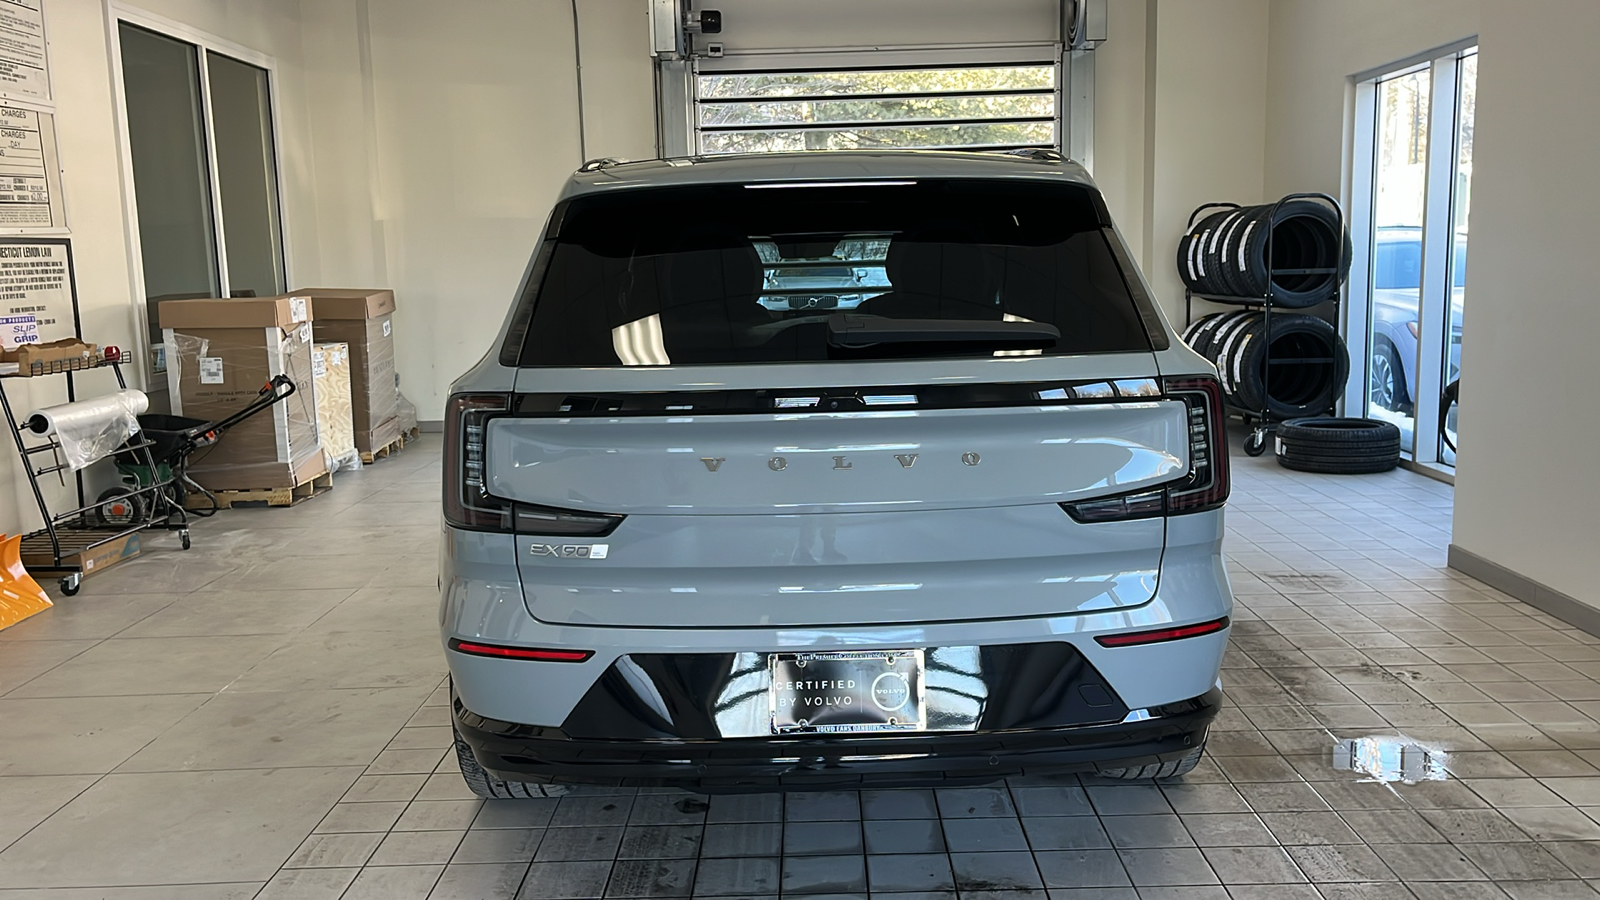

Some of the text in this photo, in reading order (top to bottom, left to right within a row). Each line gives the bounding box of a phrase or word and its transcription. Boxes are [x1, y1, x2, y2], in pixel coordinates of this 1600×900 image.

[1, 109, 26, 119] CHARGES
[1, 130, 26, 139] CHARGES
[23, 247, 40, 258] LEMON
[41, 247, 52, 258] LAW
[13, 324, 36, 333] SLIP
[14, 335, 38, 343] GRIP
[700, 451, 981, 472] VOLVO
[530, 543, 590, 558] EX90
[775, 680, 856, 690] CERTIFIED
[779, 696, 852, 707] BY VOLVO
[816, 725, 835, 733] VOLVO
